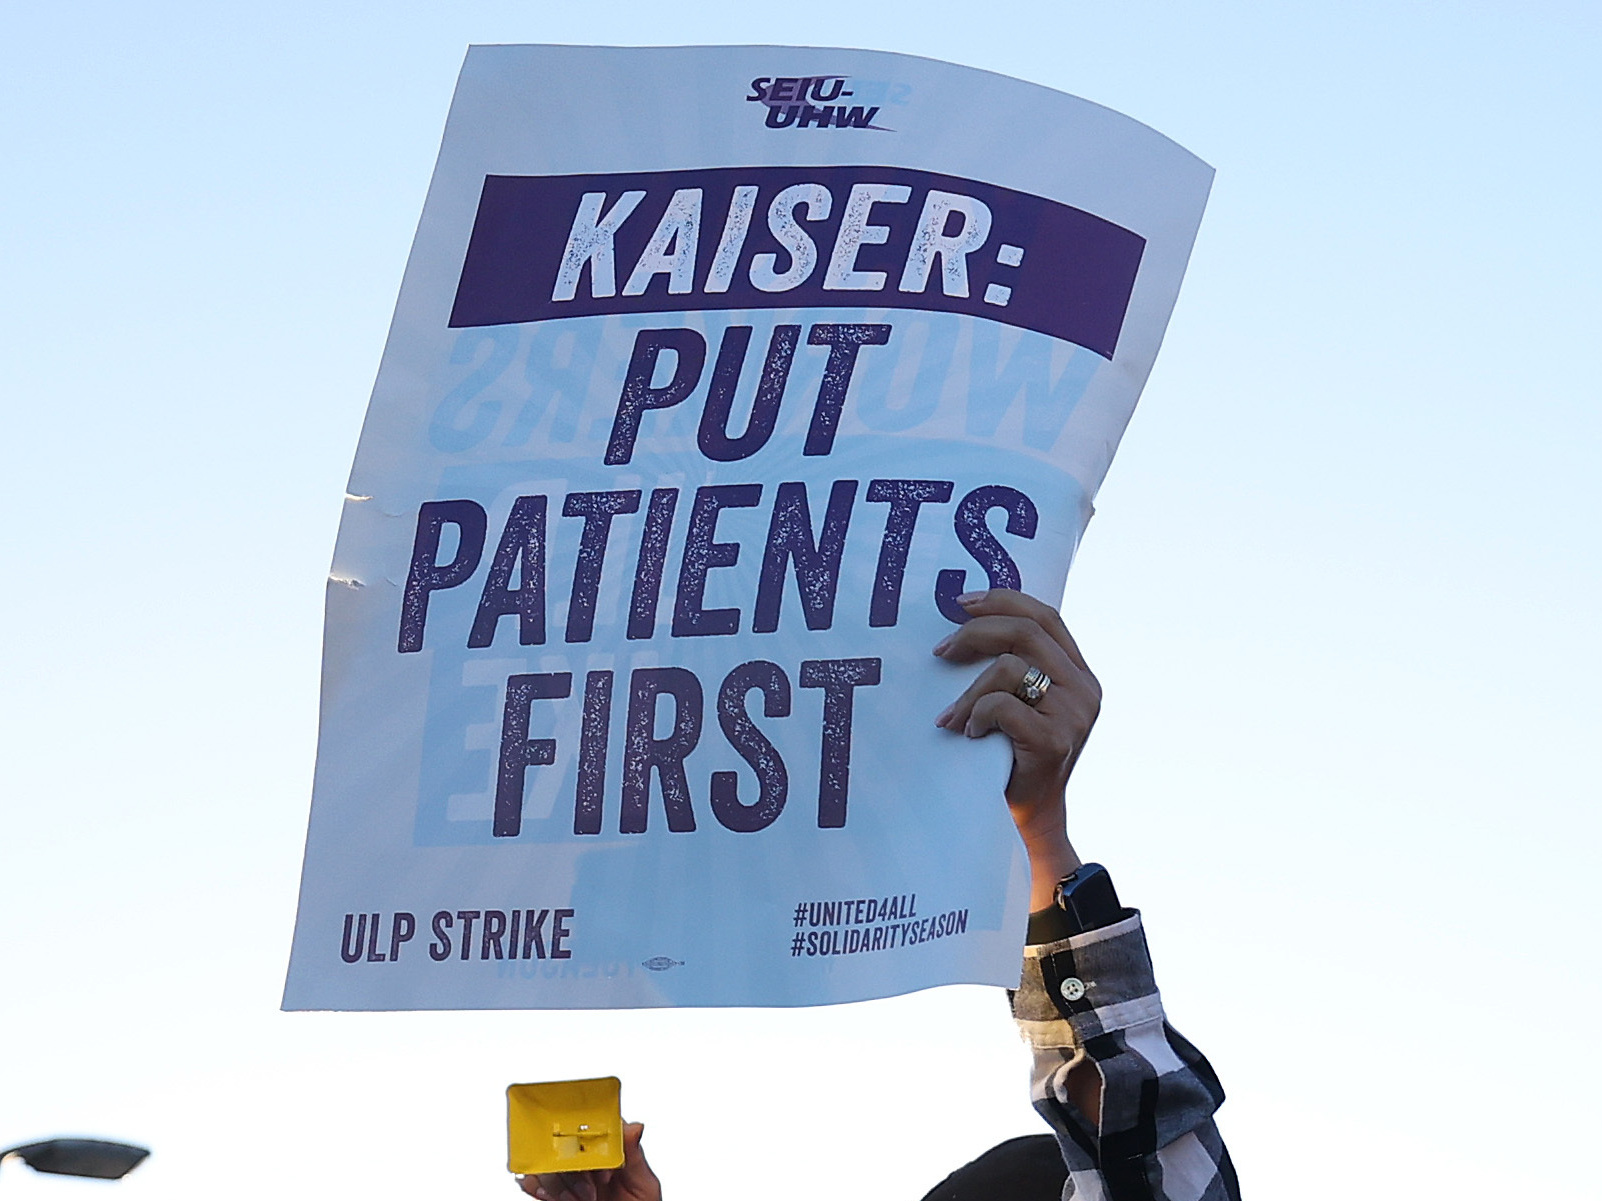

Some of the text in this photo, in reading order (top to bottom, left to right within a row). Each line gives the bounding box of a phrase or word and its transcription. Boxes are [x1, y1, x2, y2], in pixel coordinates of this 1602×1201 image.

[746, 76, 854, 102] SEIU-
[764, 105, 880, 129] UHW
[550, 182, 1026, 307] KAISER:
[603, 323, 893, 466] PUT
[397, 478, 1040, 654] PATIENTS
[493, 657, 882, 838] FIRST
[340, 908, 575, 964] ULP STRIKE
[790, 908, 969, 957] #SOLIDARITYSEASON
[793, 893, 917, 928] #UNITED4ALL
